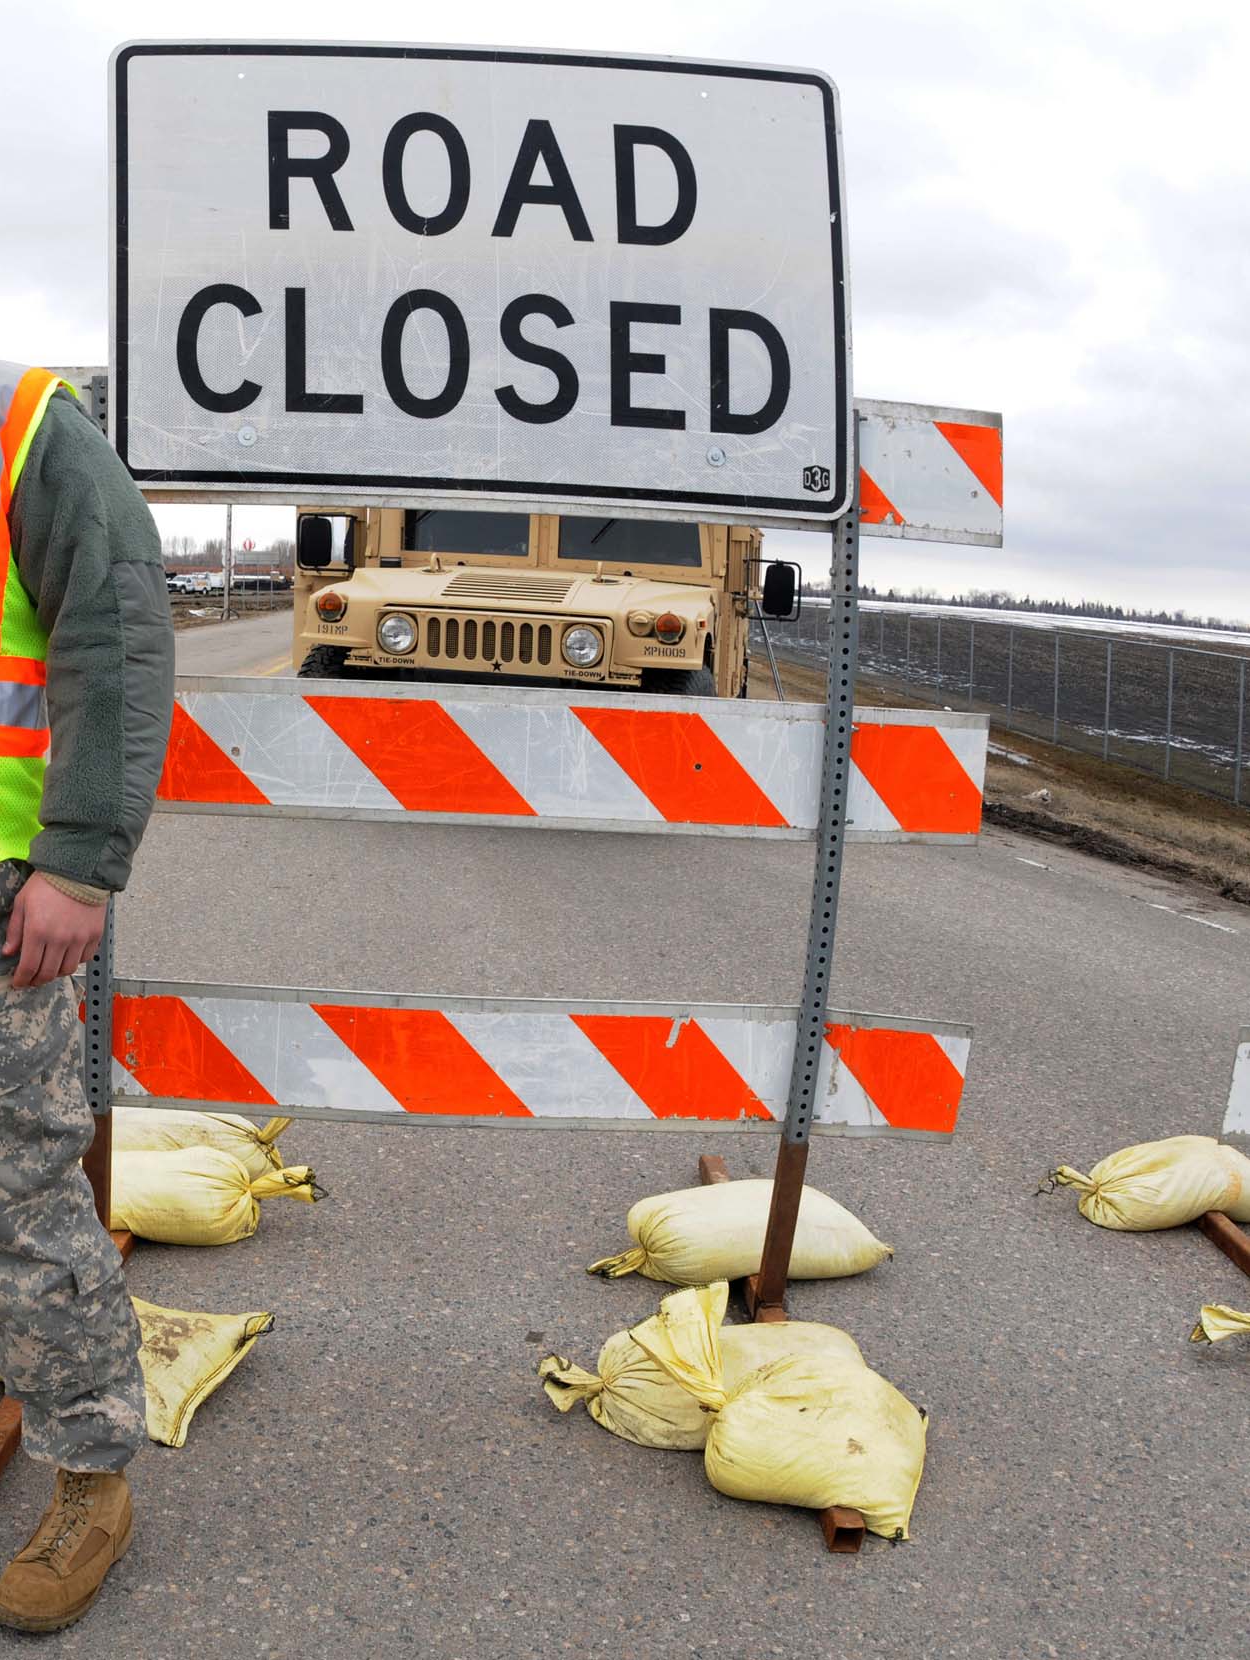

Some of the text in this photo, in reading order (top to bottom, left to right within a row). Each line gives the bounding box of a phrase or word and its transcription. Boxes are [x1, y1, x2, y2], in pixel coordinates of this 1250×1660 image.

[267, 110, 697, 246] ROAD
[176, 283, 791, 435] CLOSED
[378, 656, 415, 665] TIE-DOWN
[564, 669, 602, 678] TIE-DOWN
